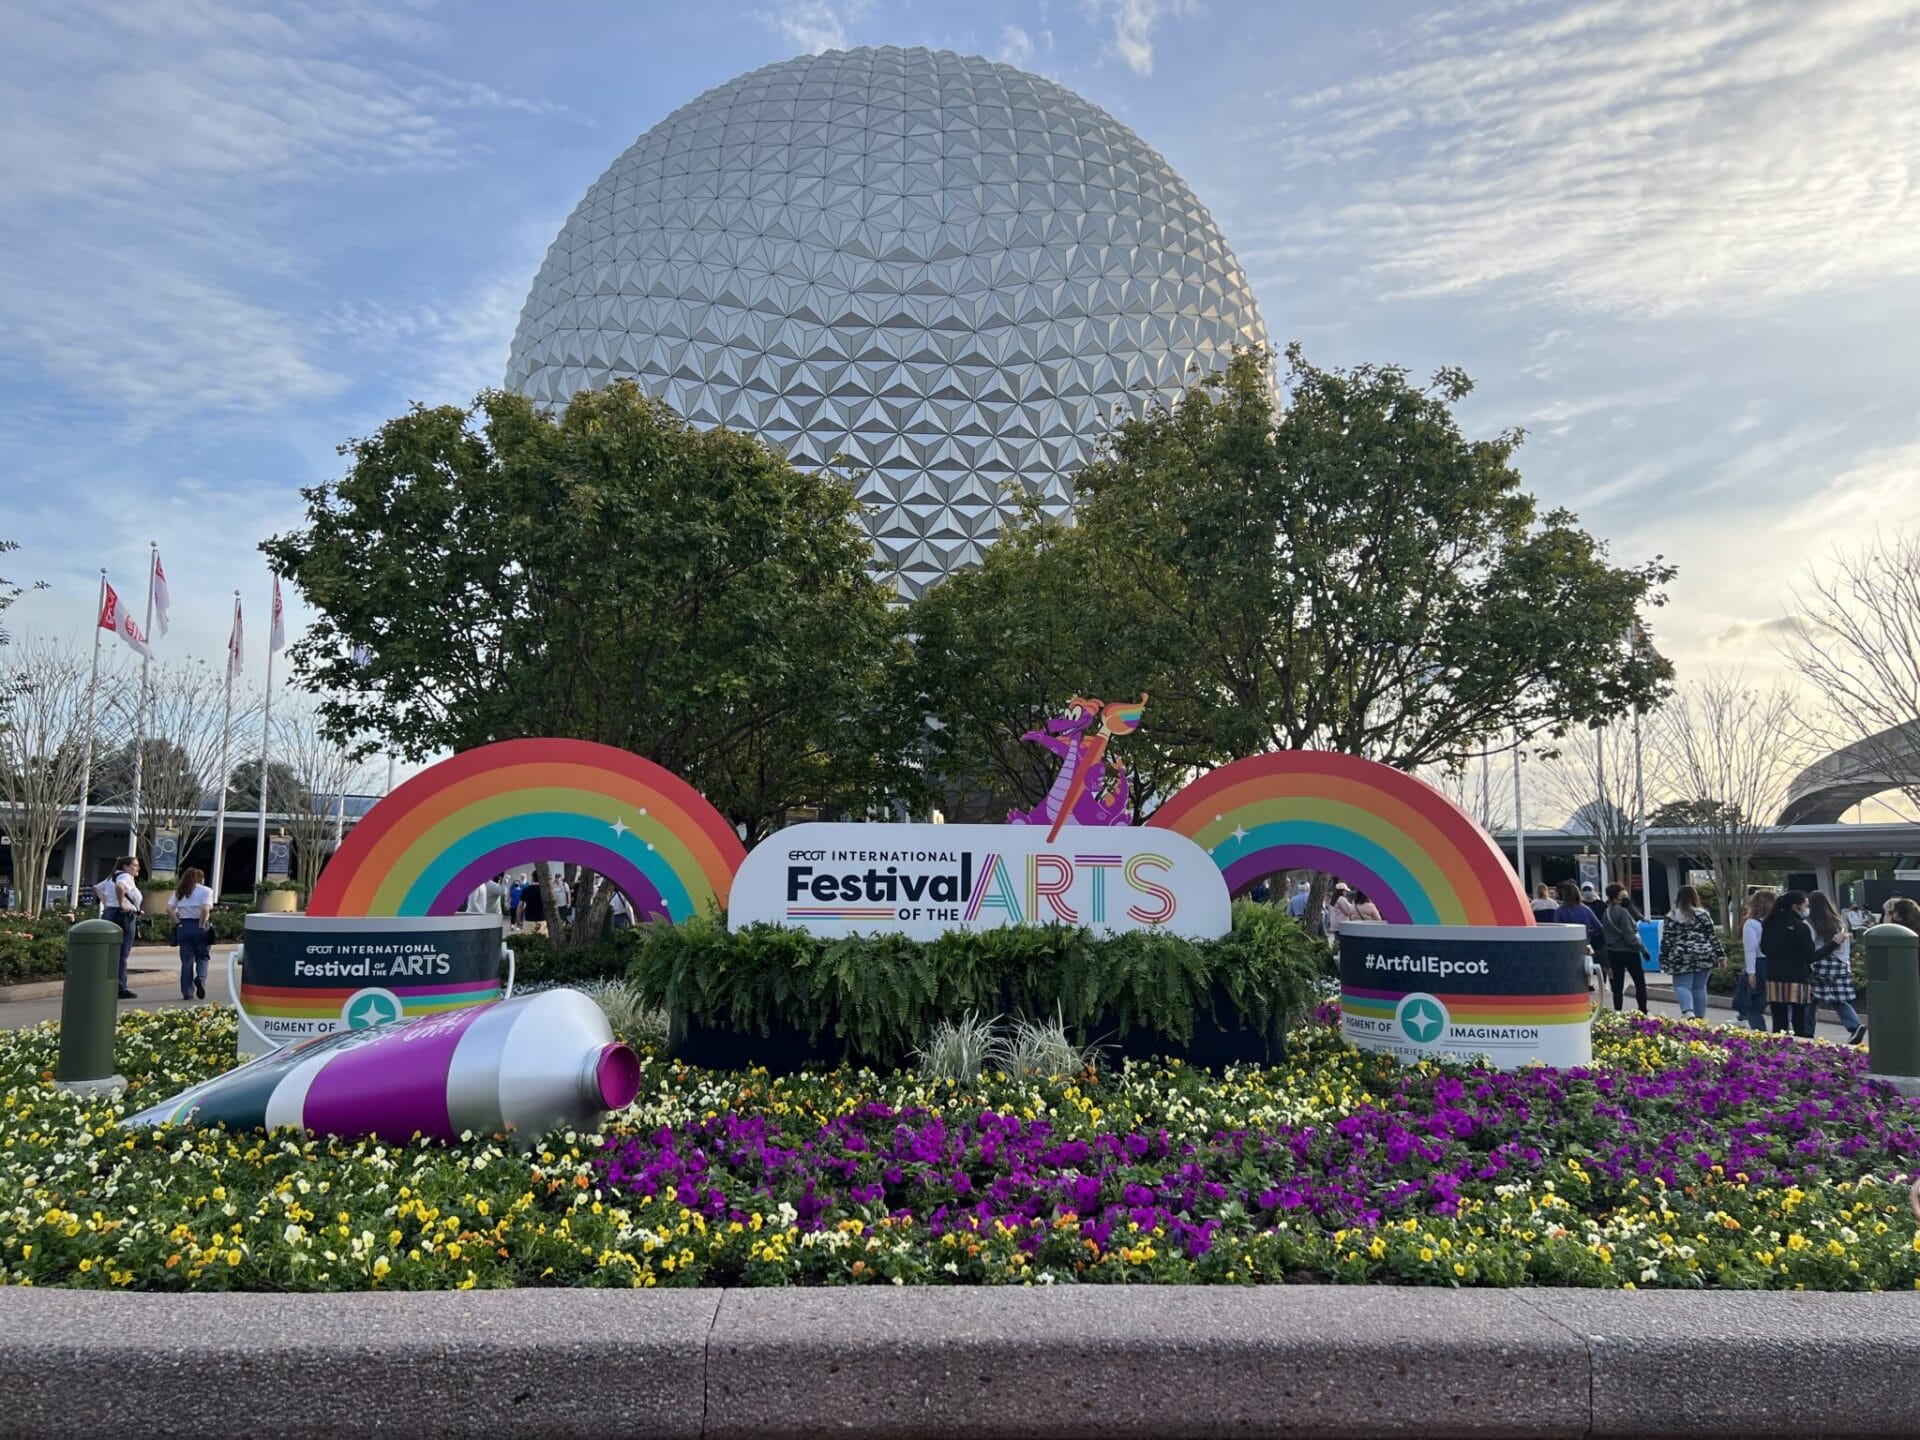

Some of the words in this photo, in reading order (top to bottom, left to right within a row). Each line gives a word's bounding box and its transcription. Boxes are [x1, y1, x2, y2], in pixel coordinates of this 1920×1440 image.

[788, 850, 827, 861] EPCOT
[832, 851, 957, 862] INTERNATIONAL
[787, 852, 972, 902] Festival
[963, 853, 1177, 924] ARTS
[898, 908, 921, 921] OF
[927, 908, 959, 921] THE
[306, 945, 334, 955] EPCOT
[337, 944, 436, 954] INTERNATIONAL
[294, 958, 370, 976] Festival
[389, 953, 450, 976] ARTS
[1365, 954, 1489, 977] #ArtfulEpcot
[264, 1021, 314, 1032] PIGMENT
[318, 1023, 336, 1032] OF
[1346, 1017, 1375, 1031] PIGMENT
[1378, 1022, 1392, 1032] OF
[1450, 1028, 1539, 1039] IMAGINATION
[1394, 1047, 1423, 1056] SERIES
